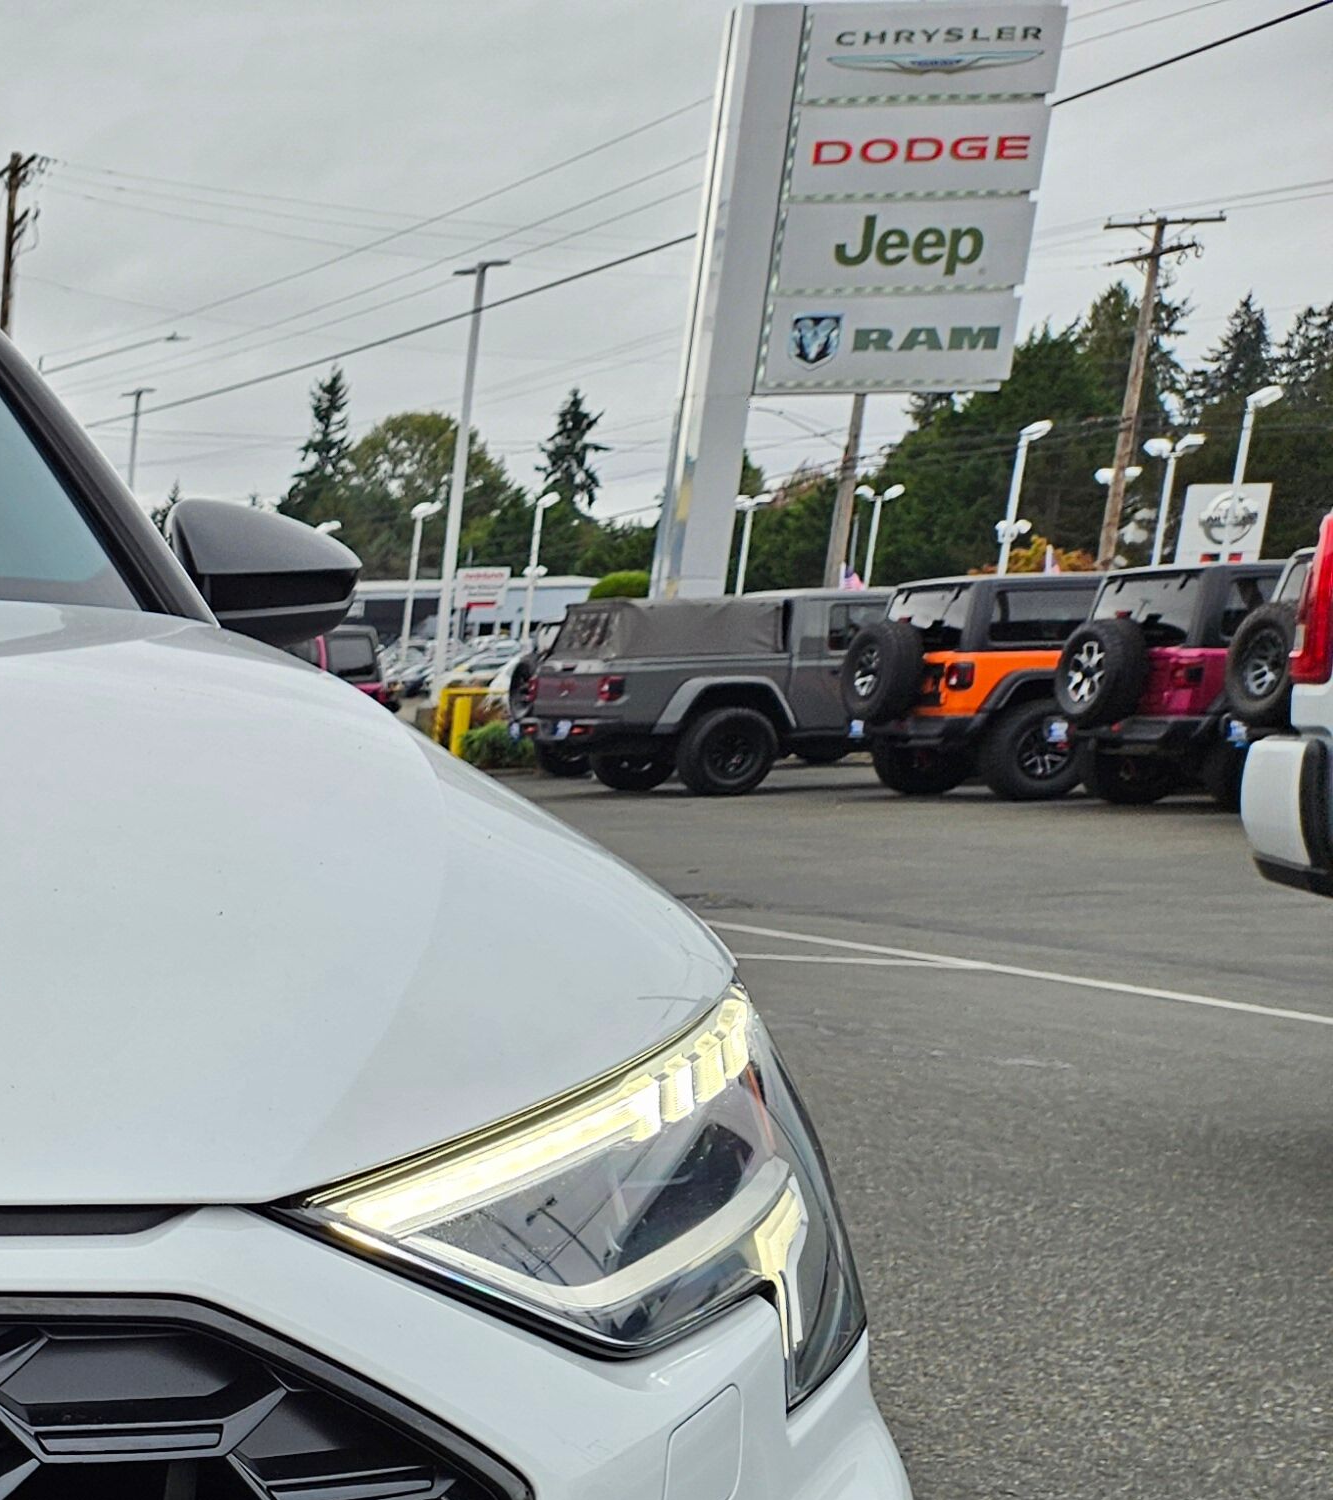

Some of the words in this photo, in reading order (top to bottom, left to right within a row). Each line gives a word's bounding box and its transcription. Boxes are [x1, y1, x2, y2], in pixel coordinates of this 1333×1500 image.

[835, 25, 1044, 47] CHRYSLER
[811, 134, 1032, 166] DODGE
[834, 213, 985, 277] Jeep
[850, 326, 1002, 353] RAM
